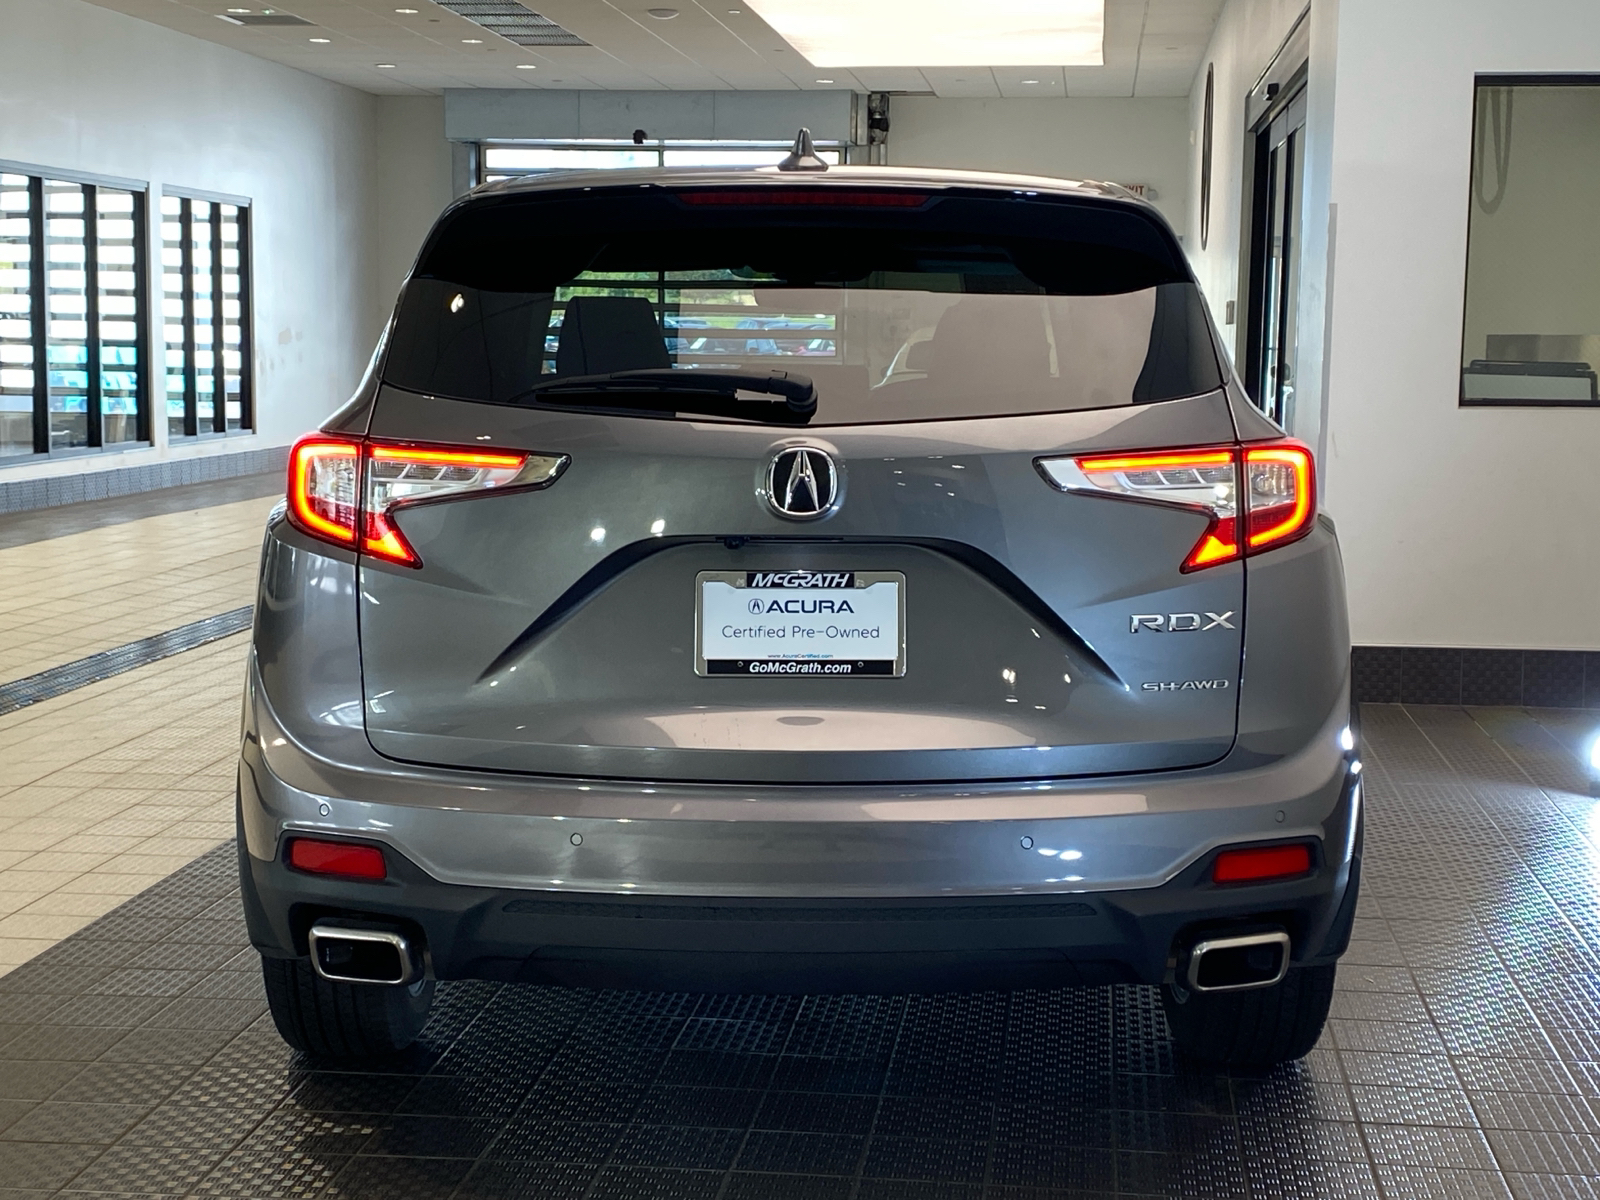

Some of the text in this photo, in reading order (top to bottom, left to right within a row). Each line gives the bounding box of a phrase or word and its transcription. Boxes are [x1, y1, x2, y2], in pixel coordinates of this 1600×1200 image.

[766, 600, 855, 614] ACURA
[1130, 610, 1237, 633] RDX
[721, 625, 880, 639] Certified Pre-Owned
[749, 661, 852, 673] GoMcGrath.com
